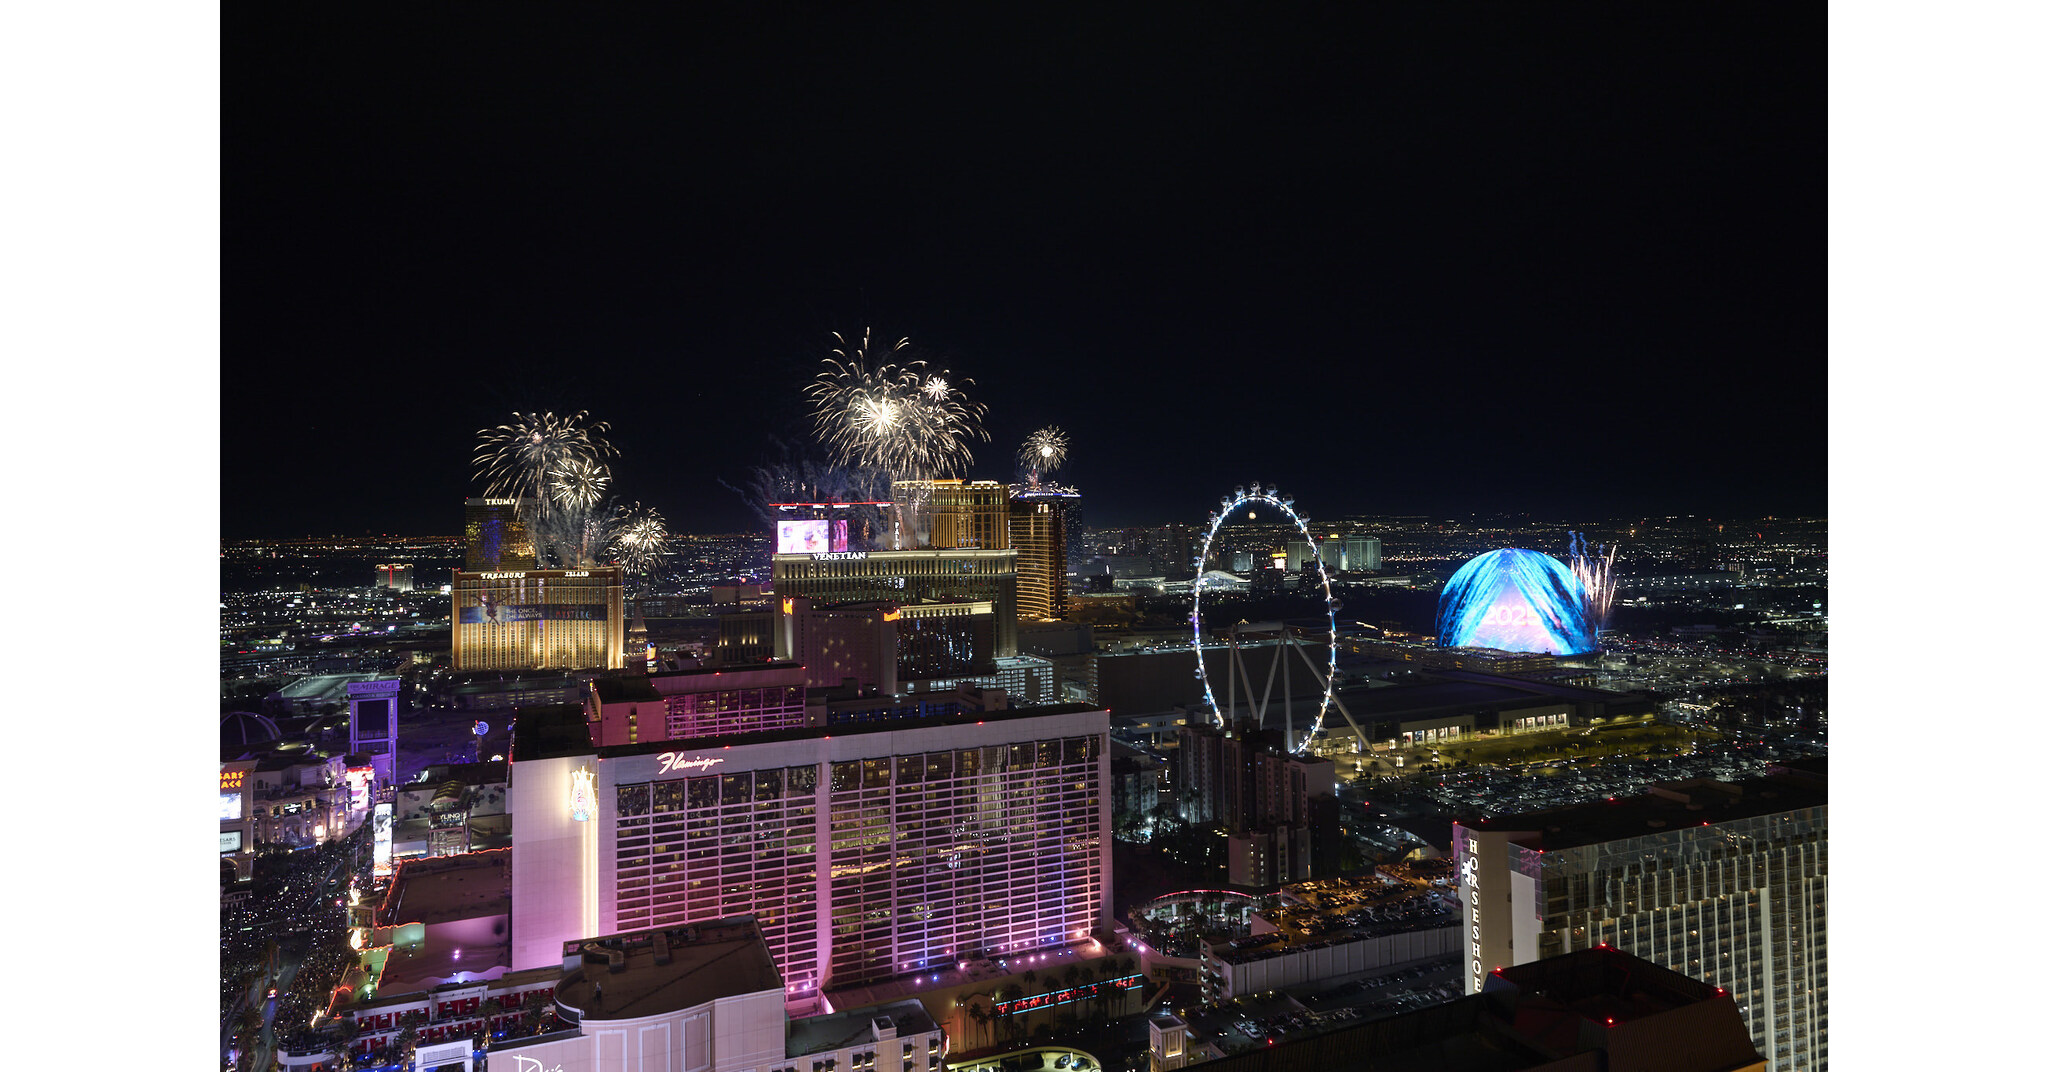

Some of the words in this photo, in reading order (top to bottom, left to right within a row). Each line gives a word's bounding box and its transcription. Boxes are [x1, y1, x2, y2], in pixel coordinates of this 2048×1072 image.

[812, 551, 866, 561] VENETIAN
[480, 572, 526, 580] TREASURE
[1481, 604, 1541, 626] 2025
[360, 682, 397, 690] MIRAGE
[656, 752, 724, 775] Flamingo
[1468, 838, 1482, 993] HORSESHOE
